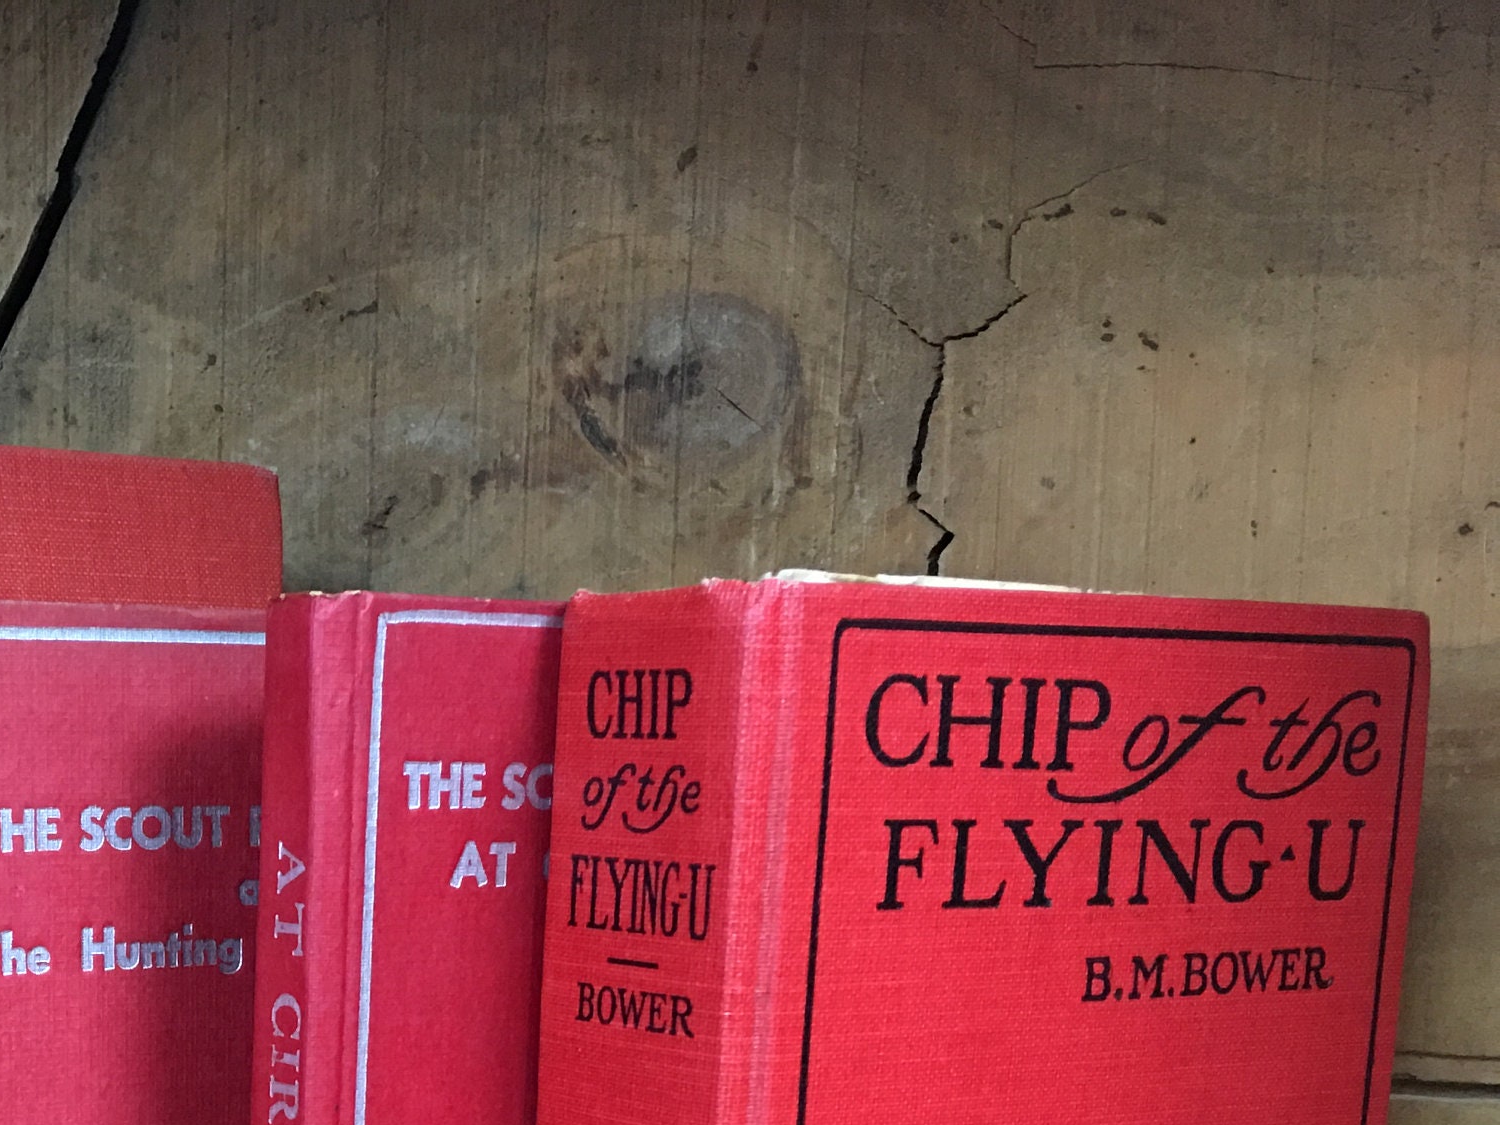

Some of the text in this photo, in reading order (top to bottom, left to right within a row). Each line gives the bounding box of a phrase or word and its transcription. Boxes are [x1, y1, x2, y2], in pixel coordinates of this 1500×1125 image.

[587, 668, 694, 740] CHIP
[865, 673, 1382, 804] CHIP of the
[403, 760, 487, 810] THE
[581, 763, 702, 834] of the
[80, 804, 231, 852] SCOUT
[450, 840, 517, 888] AT
[273, 841, 307, 959] AT
[81, 923, 243, 976] Hunting
[575, 981, 695, 1039] BOWER
